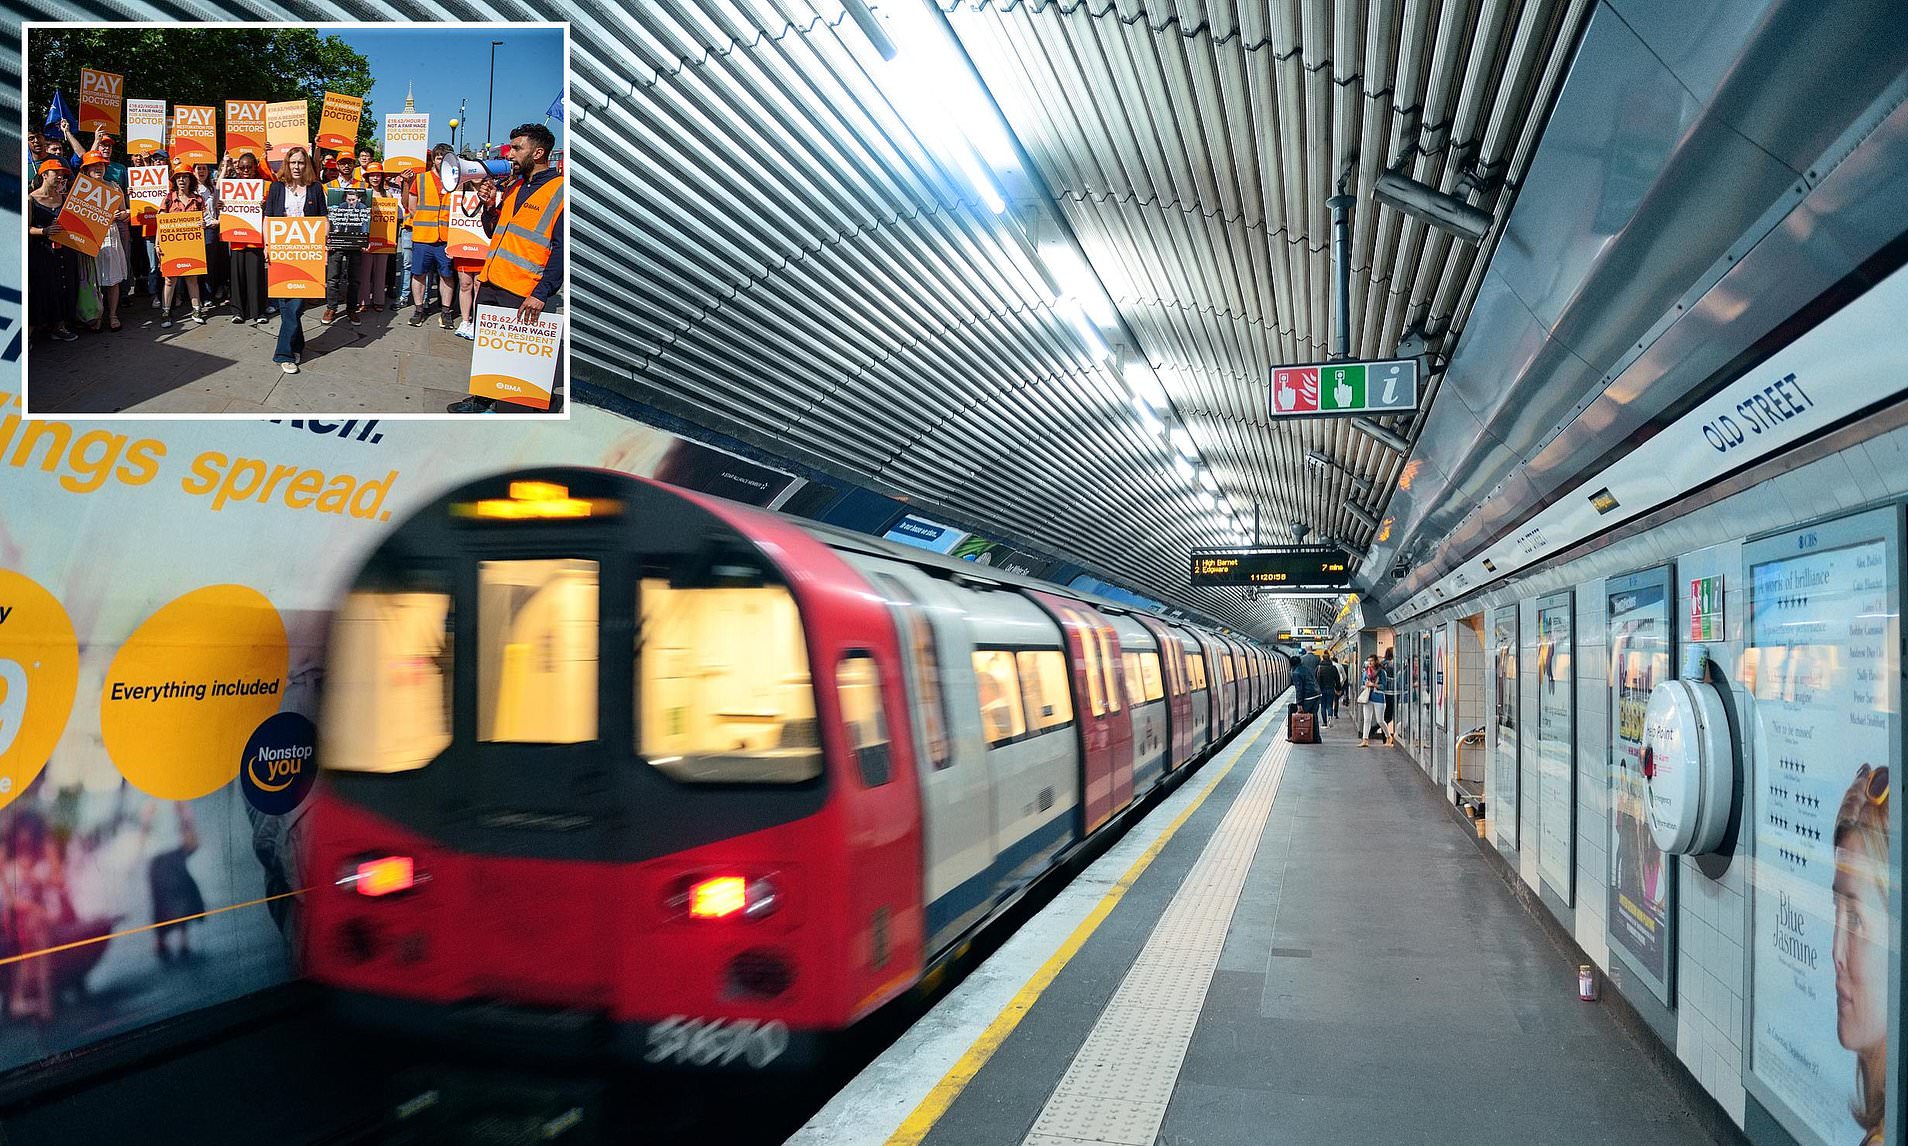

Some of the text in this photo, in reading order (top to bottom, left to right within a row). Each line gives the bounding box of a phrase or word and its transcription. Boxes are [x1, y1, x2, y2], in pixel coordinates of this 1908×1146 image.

[83, 71, 121, 94] PAY
[82, 95, 120, 107] DOCTORS
[176, 108, 213, 125] PAY
[227, 103, 264, 120] PAY
[324, 110, 358, 122] DOCTOR
[129, 117, 163, 125] DOCTOR
[268, 119, 306, 129] DOCTOR
[176, 129, 214, 137] DOCTORS
[387, 133, 425, 141] DOCTOR
[130, 168, 166, 186] PAY
[72, 176, 120, 211] PAY
[131, 190, 167, 198] DOCTORS
[222, 182, 260, 200] PAY
[66, 201, 110, 226] DOCTORS
[222, 205, 260, 213] DOCTORS
[372, 215, 395, 223] CTOR
[451, 219, 482, 227] DOCTO
[161, 232, 202, 242] DOCTOR
[270, 221, 322, 244] PAY
[270, 251, 322, 261] DOCTORS
[480, 321, 498, 329] NOT
[508, 325, 527, 333] FAIR
[530, 328, 556, 337] WAGE
[548, 322, 557, 330] IS
[480, 328, 497, 336] FOR
[508, 333, 555, 344] RESIDENT
[478, 336, 553, 358] DOCTOR
[504, 384, 521, 392] BMA
[1703, 373, 1814, 452] OLD STREET
[0, 396, 399, 522] ings spread.
[111, 678, 279, 702] Everything included
[258, 744, 312, 762] Nonstop
[267, 758, 301, 781] you
[1779, 891, 1805, 935] Blue
[1773, 914, 1817, 970] Jasmine
